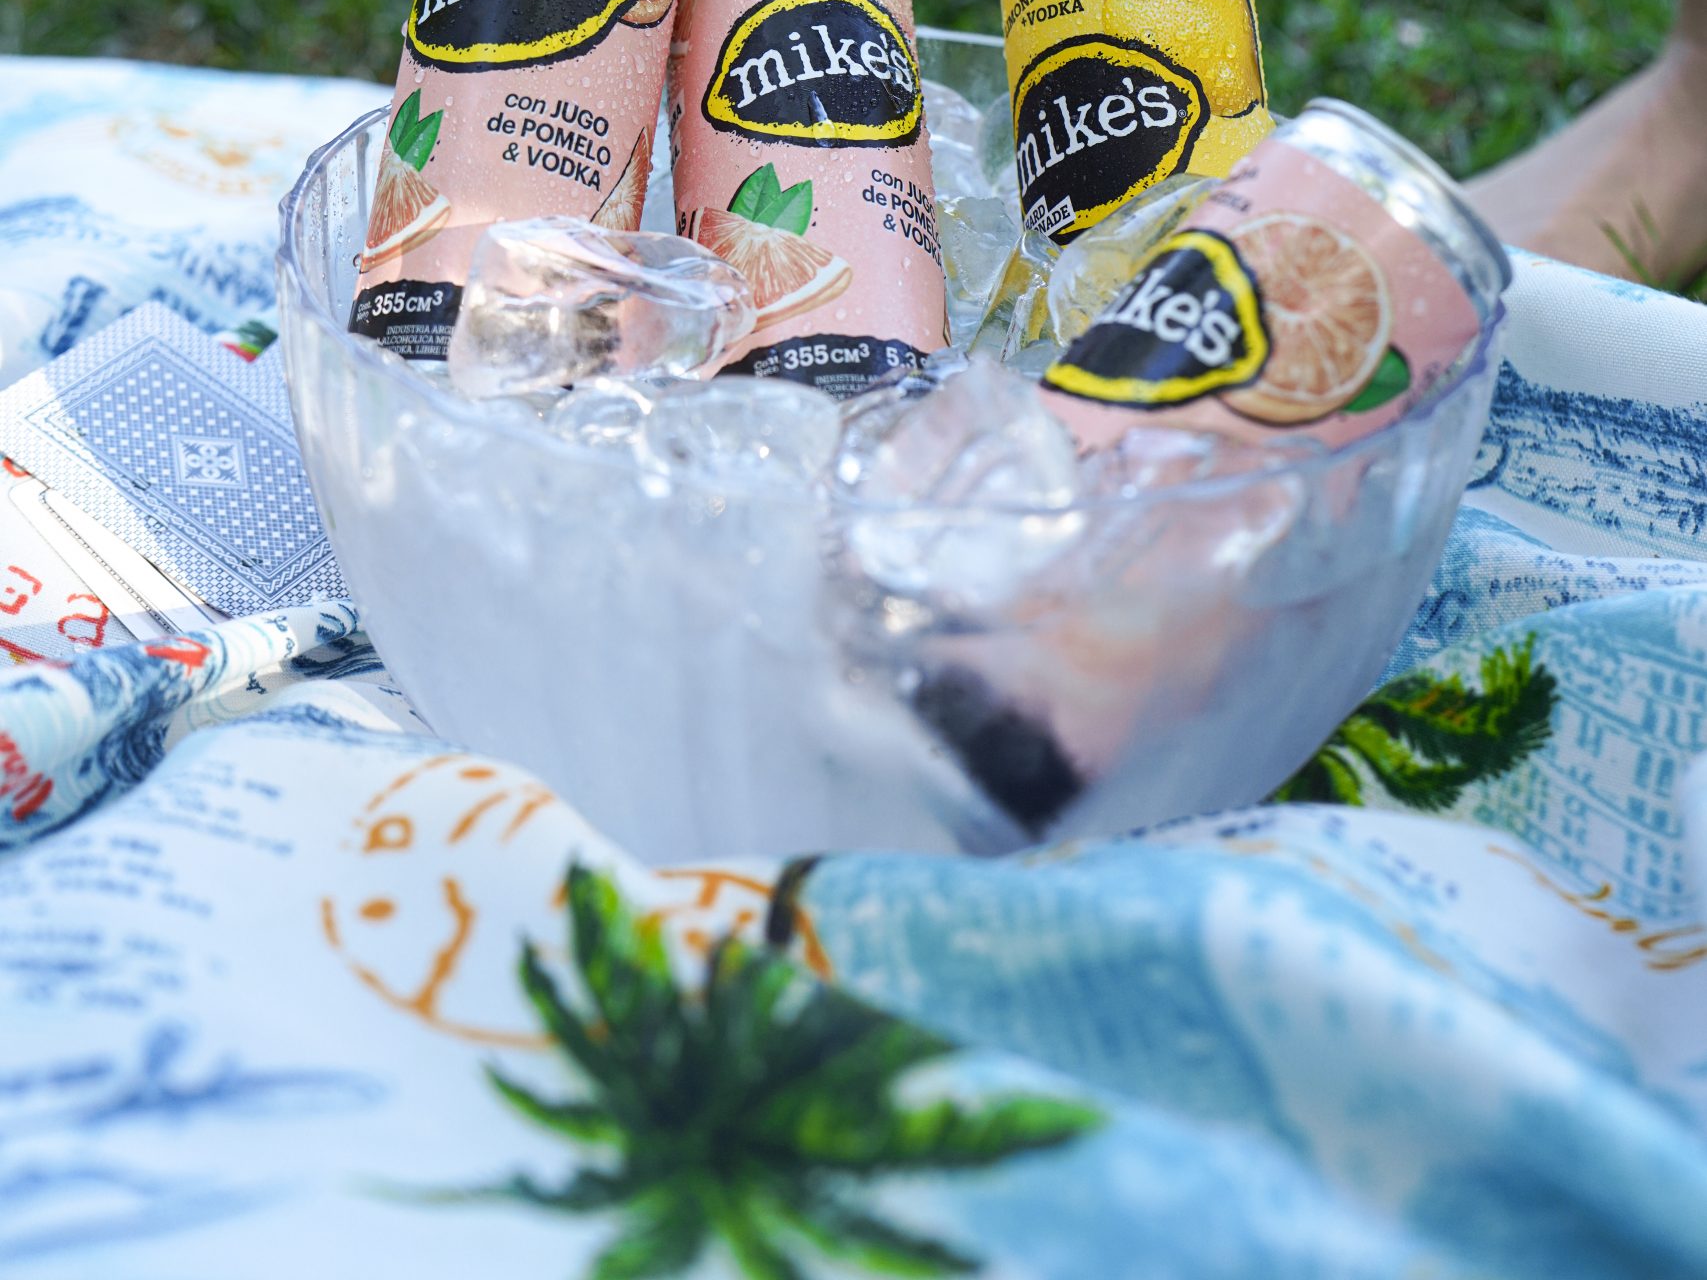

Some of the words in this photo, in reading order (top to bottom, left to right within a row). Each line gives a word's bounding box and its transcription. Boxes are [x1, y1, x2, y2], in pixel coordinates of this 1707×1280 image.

[730, 24, 913, 109] mike's
[487, 113, 515, 135] de
[521, 119, 611, 166] POMELO
[505, 93, 547, 115] con
[550, 101, 609, 137] JUGO
[1017, 77, 1179, 198] mike's
[502, 142, 519, 162] &
[527, 146, 600, 192] VODKA
[871, 169, 903, 192] con
[862, 185, 887, 206] de
[883, 214, 896, 232] &
[1100, 268, 1240, 368] ke's
